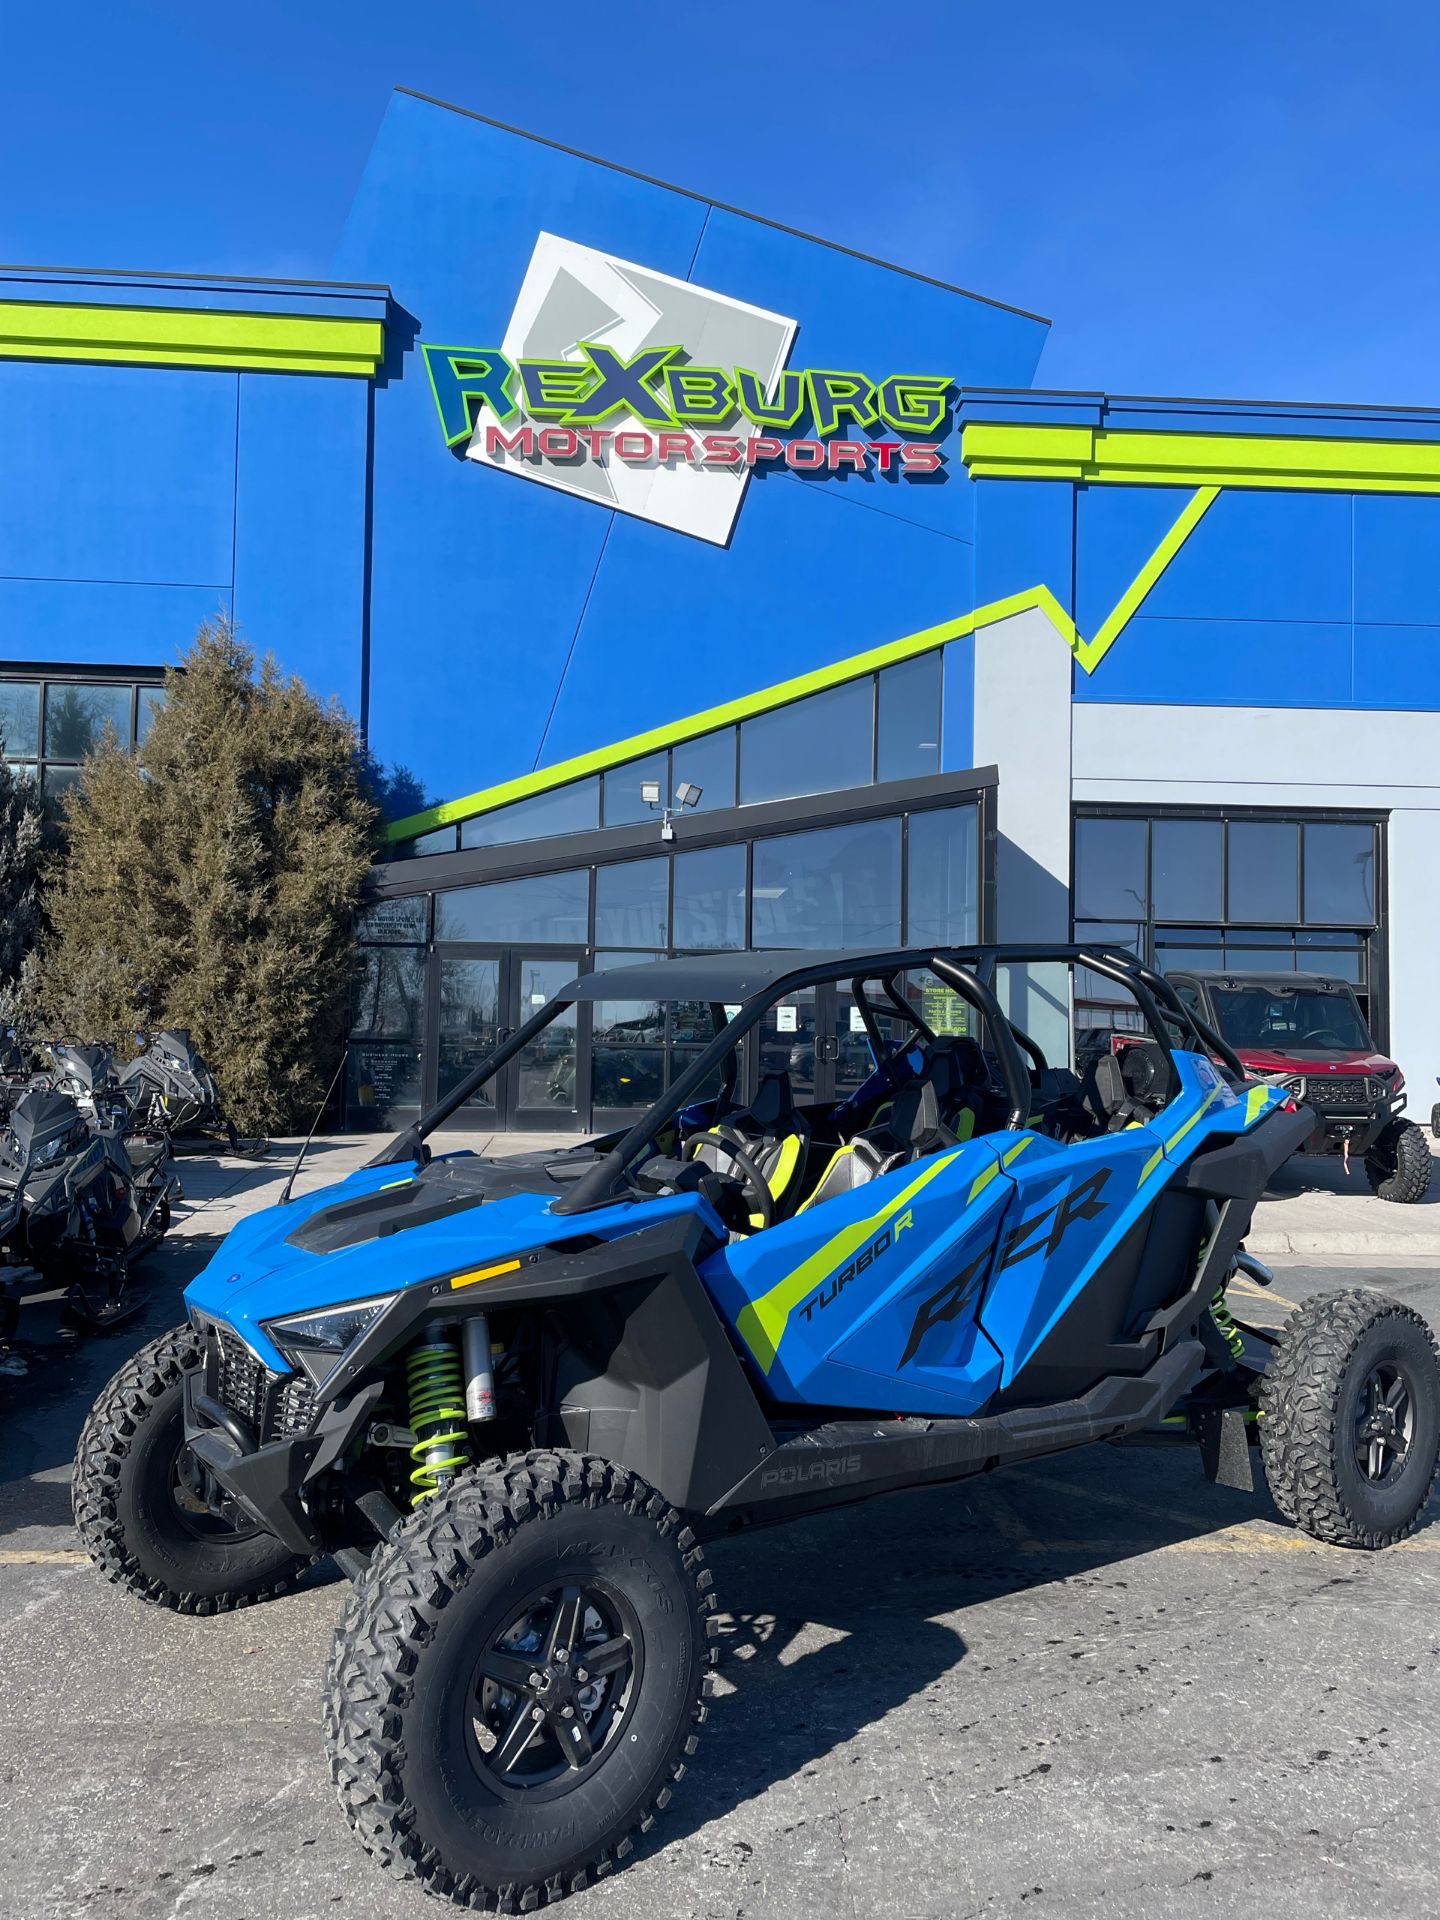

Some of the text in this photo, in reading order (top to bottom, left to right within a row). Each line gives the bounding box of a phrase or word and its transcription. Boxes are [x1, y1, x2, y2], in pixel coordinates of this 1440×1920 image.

[421, 341, 955, 448] REXBURG
[485, 425, 943, 473] MOTORSPORTS
[141, 1060, 166, 1081] POLARIS
[799, 1209, 914, 1323] TURBO R
[761, 1454, 862, 1488] POLARIS
